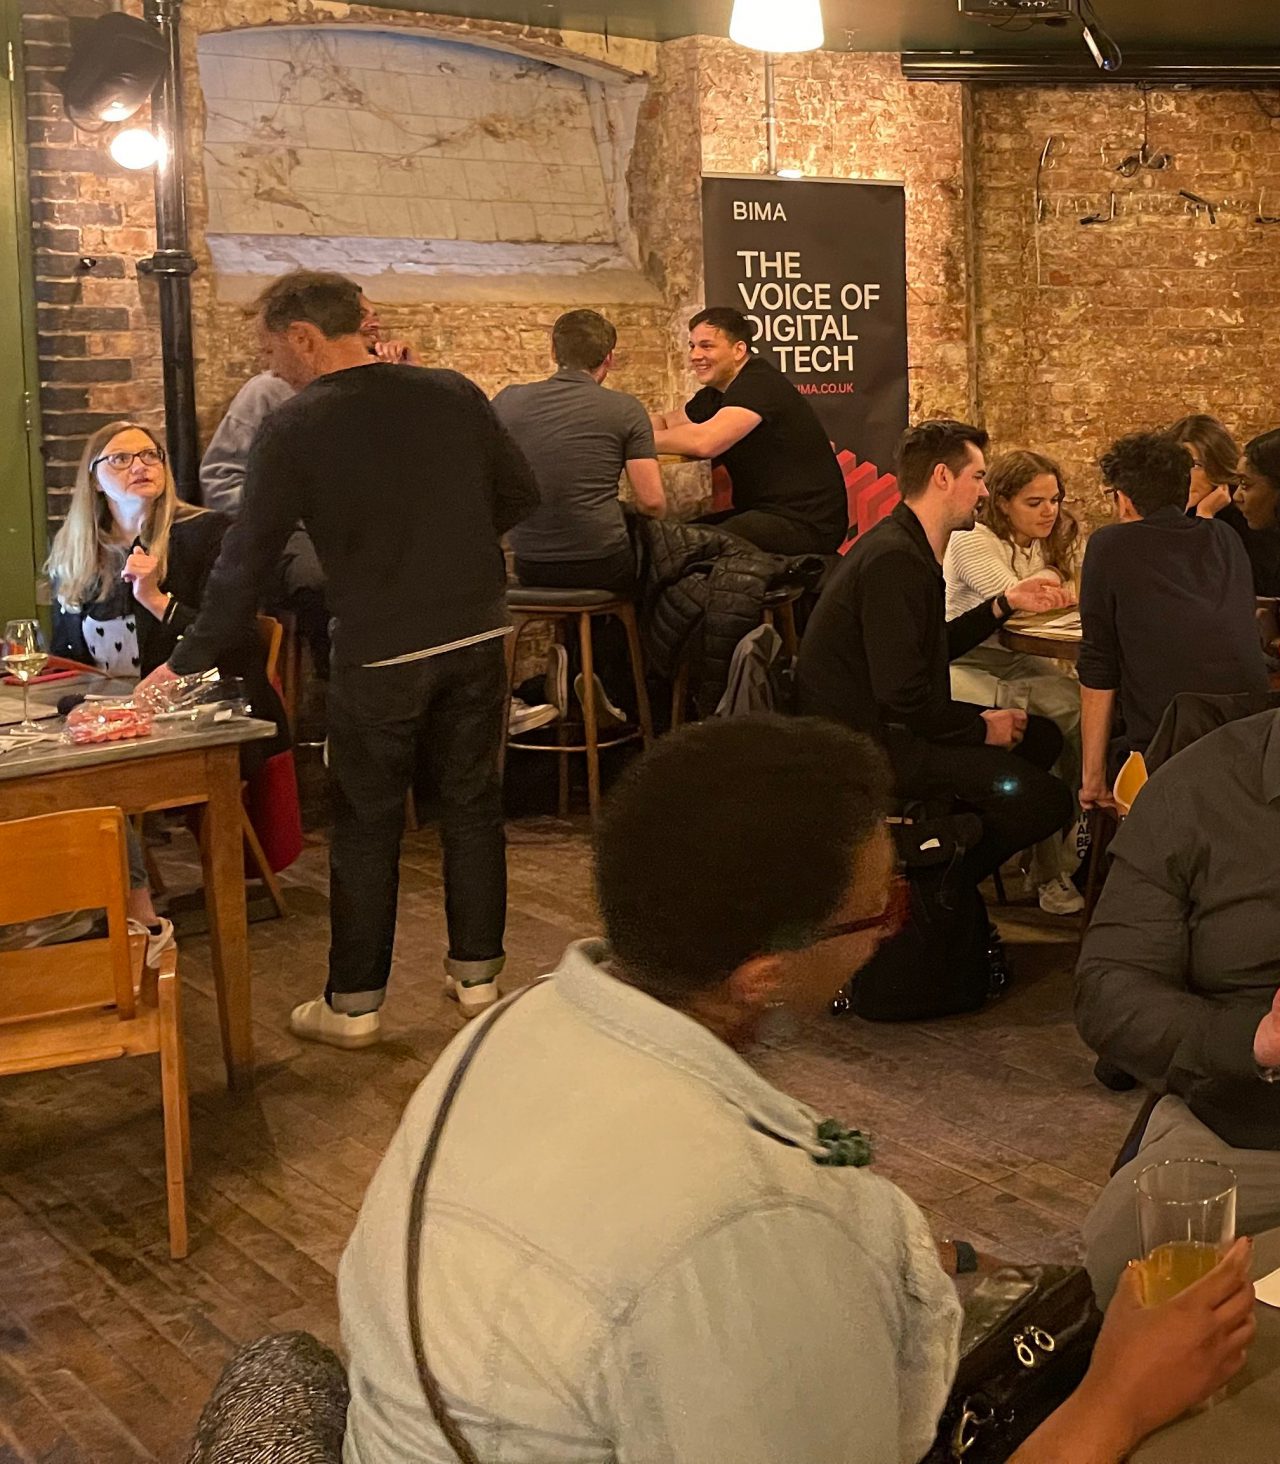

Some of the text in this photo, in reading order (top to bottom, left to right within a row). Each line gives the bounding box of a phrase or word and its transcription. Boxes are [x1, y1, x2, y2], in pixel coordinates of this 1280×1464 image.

[733, 201, 787, 222] BIMA
[737, 250, 802, 279] THE
[738, 283, 880, 311] VOICE OF
[772, 345, 854, 373] TECH
[796, 382, 854, 394] IMA.CO.UK
